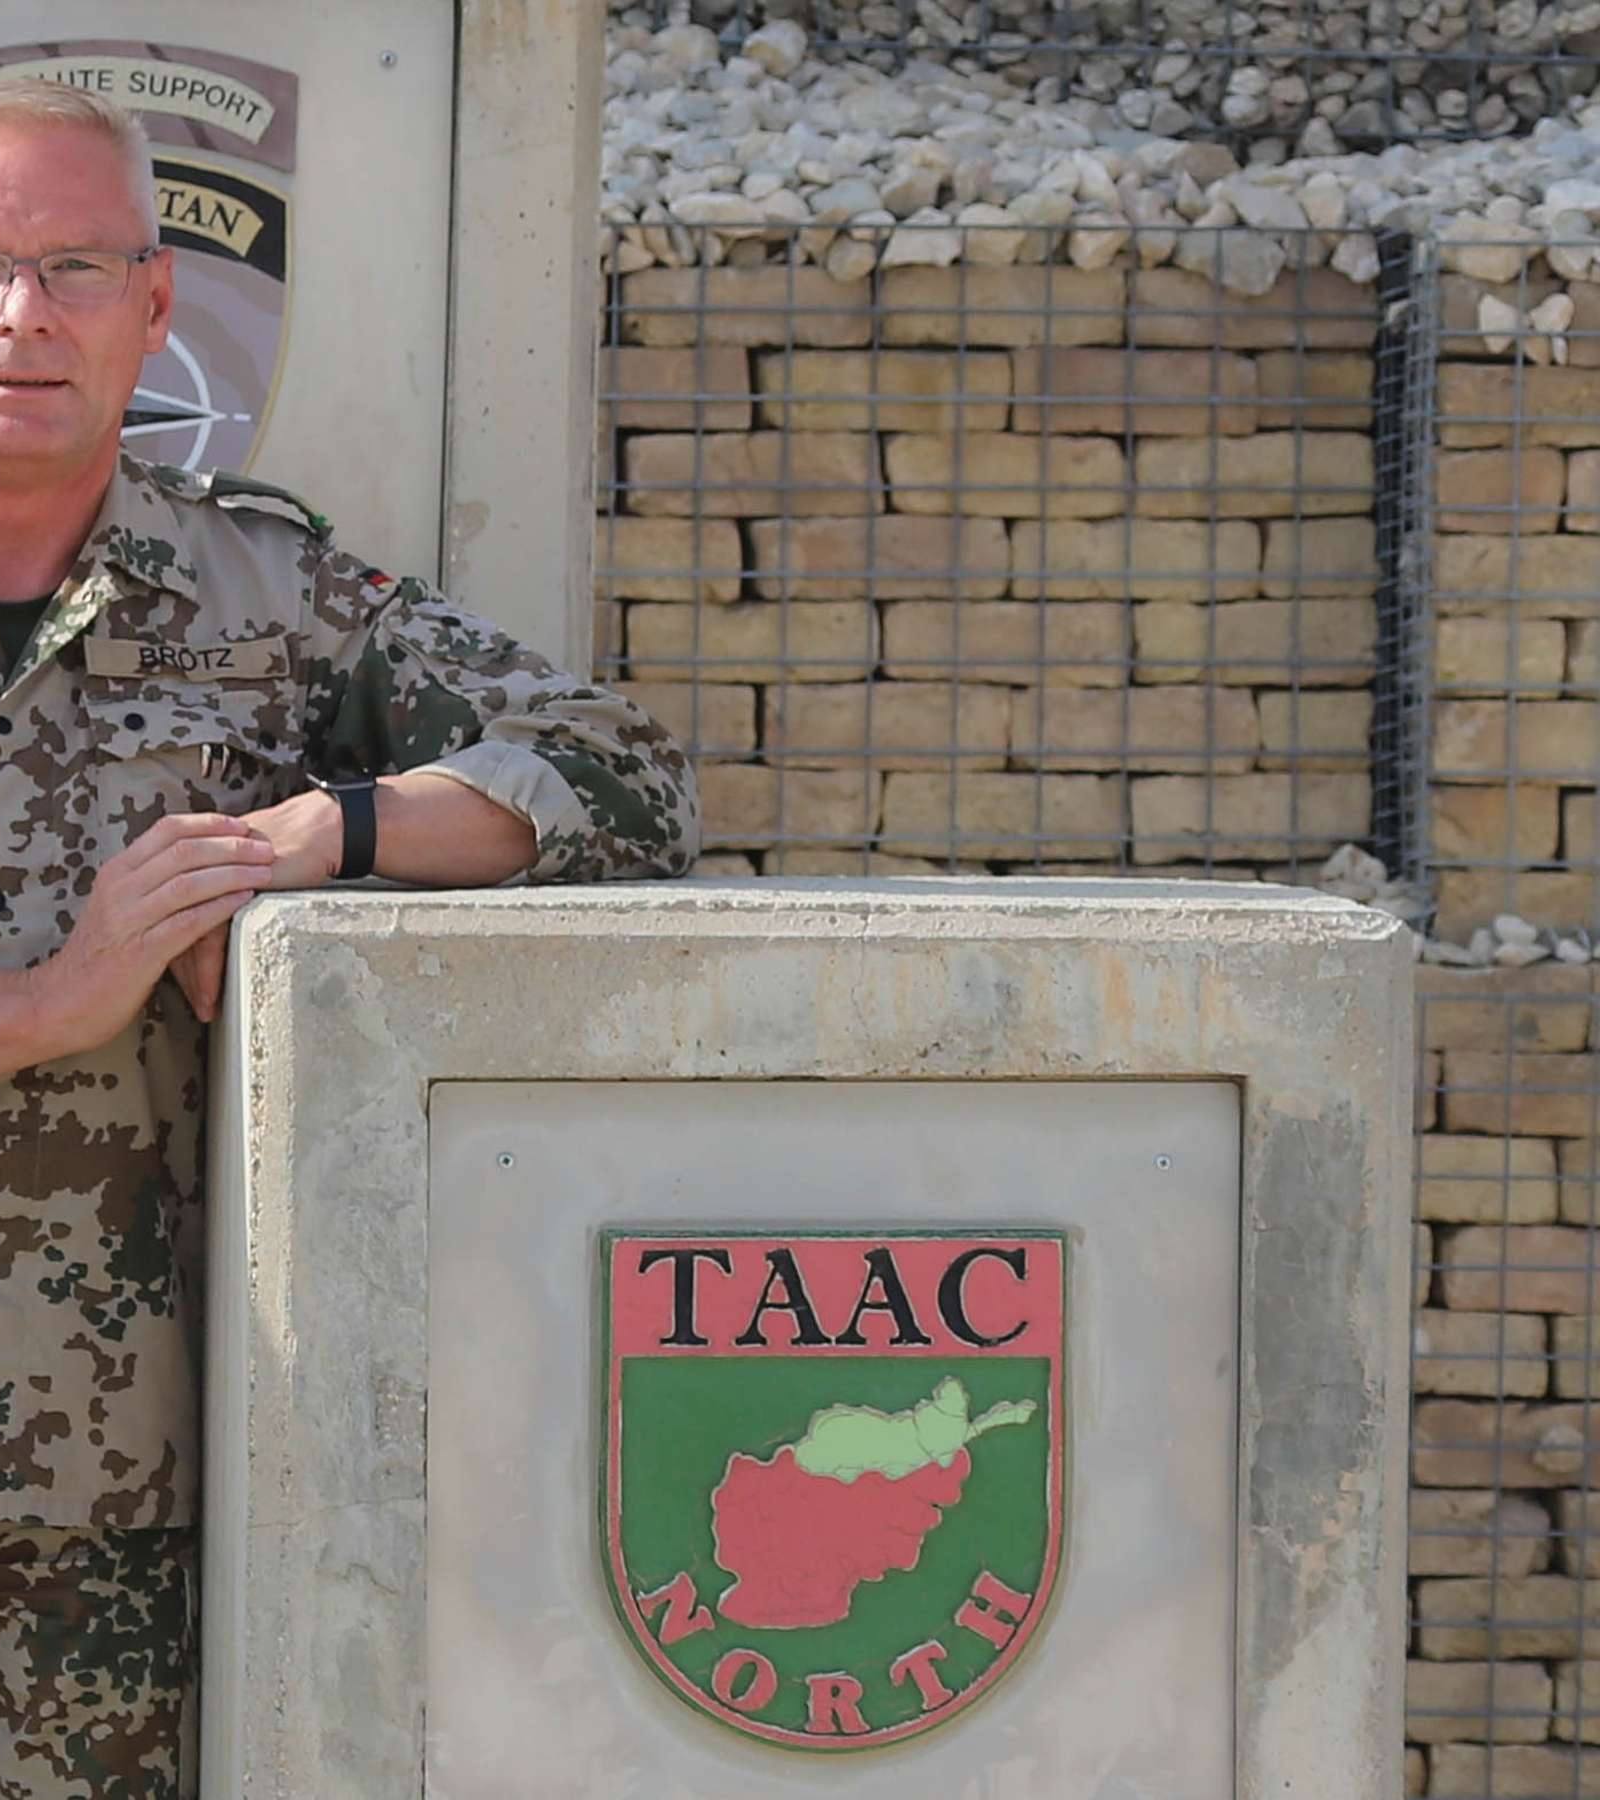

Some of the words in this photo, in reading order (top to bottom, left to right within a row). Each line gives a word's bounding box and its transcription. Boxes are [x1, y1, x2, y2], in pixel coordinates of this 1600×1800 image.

[128, 70, 262, 124] SUPPORT
[158, 187, 244, 236] TAN
[638, 1247, 1030, 1348] TAAC
[635, 1570, 1033, 1733] NORTH
